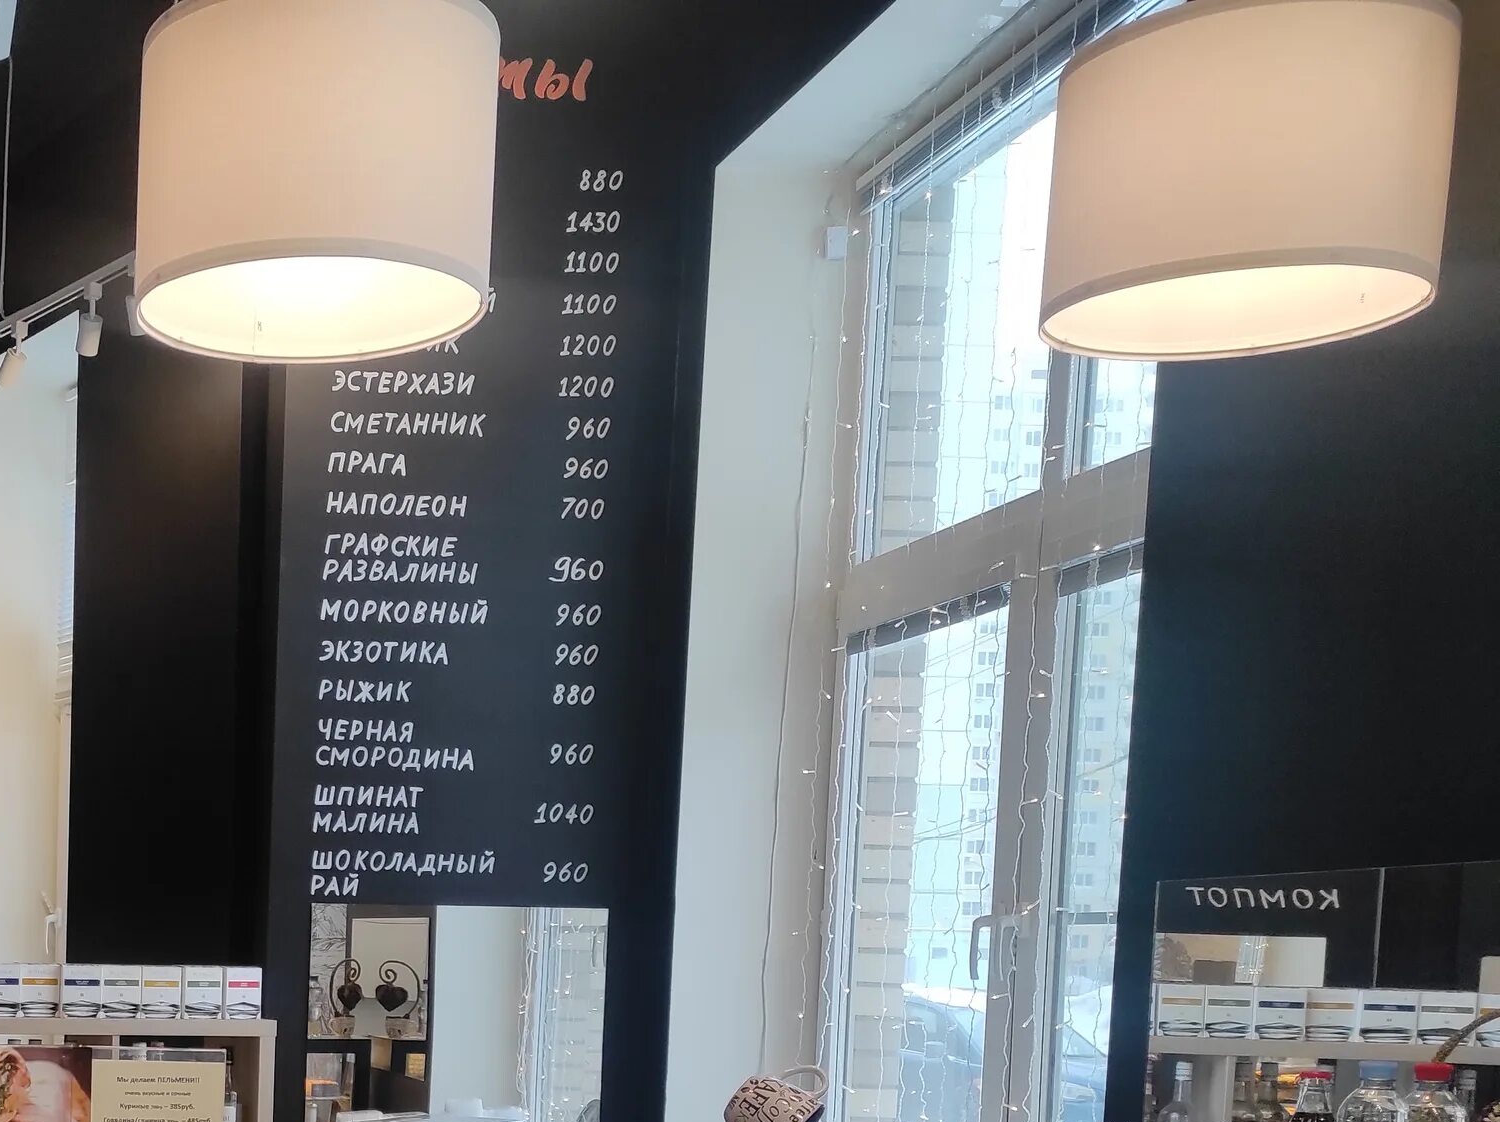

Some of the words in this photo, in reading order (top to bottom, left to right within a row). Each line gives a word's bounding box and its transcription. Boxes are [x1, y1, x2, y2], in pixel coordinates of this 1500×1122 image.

[580, 170, 623, 191] 880
[566, 211, 620, 232] 1430
[564, 251, 619, 273] 1100
[562, 294, 616, 314] 1100
[560, 335, 616, 356] 1200
[332, 370, 475, 395] ЭСТЕРХАЗИ
[559, 376, 614, 397] 1200
[331, 411, 486, 437] СМЕТАННИК
[566, 417, 610, 440] 960
[328, 451, 406, 476] ПРАГА
[564, 457, 608, 479] 960
[326, 492, 467, 517] НАПОЛЕОН
[561, 497, 604, 519] 700
[325, 533, 457, 557] ГРАФСКИЕ
[323, 559, 478, 584] РАЗВАЛИНЫ
[549, 557, 603, 582] 960
[320, 599, 488, 624] МОРКОВНЫЙ
[556, 604, 601, 626] 960
[319, 640, 448, 665] ЭКЗОТИКА
[555, 644, 598, 665] 960
[319, 679, 412, 703] РЫЖИК
[553, 684, 594, 705] 880
[319, 718, 413, 743] ЧЕРНАЯ
[316, 746, 473, 772] СМОРОДИНА
[550, 744, 593, 764] 960
[315, 785, 423, 807] ШПИНАТ
[313, 811, 418, 834] МАЛИНА
[534, 803, 593, 824] 1040
[312, 850, 495, 878] ШОКОЛАДНЫЙ
[544, 862, 588, 882] 960
[311, 873, 359, 896] РАЙ
